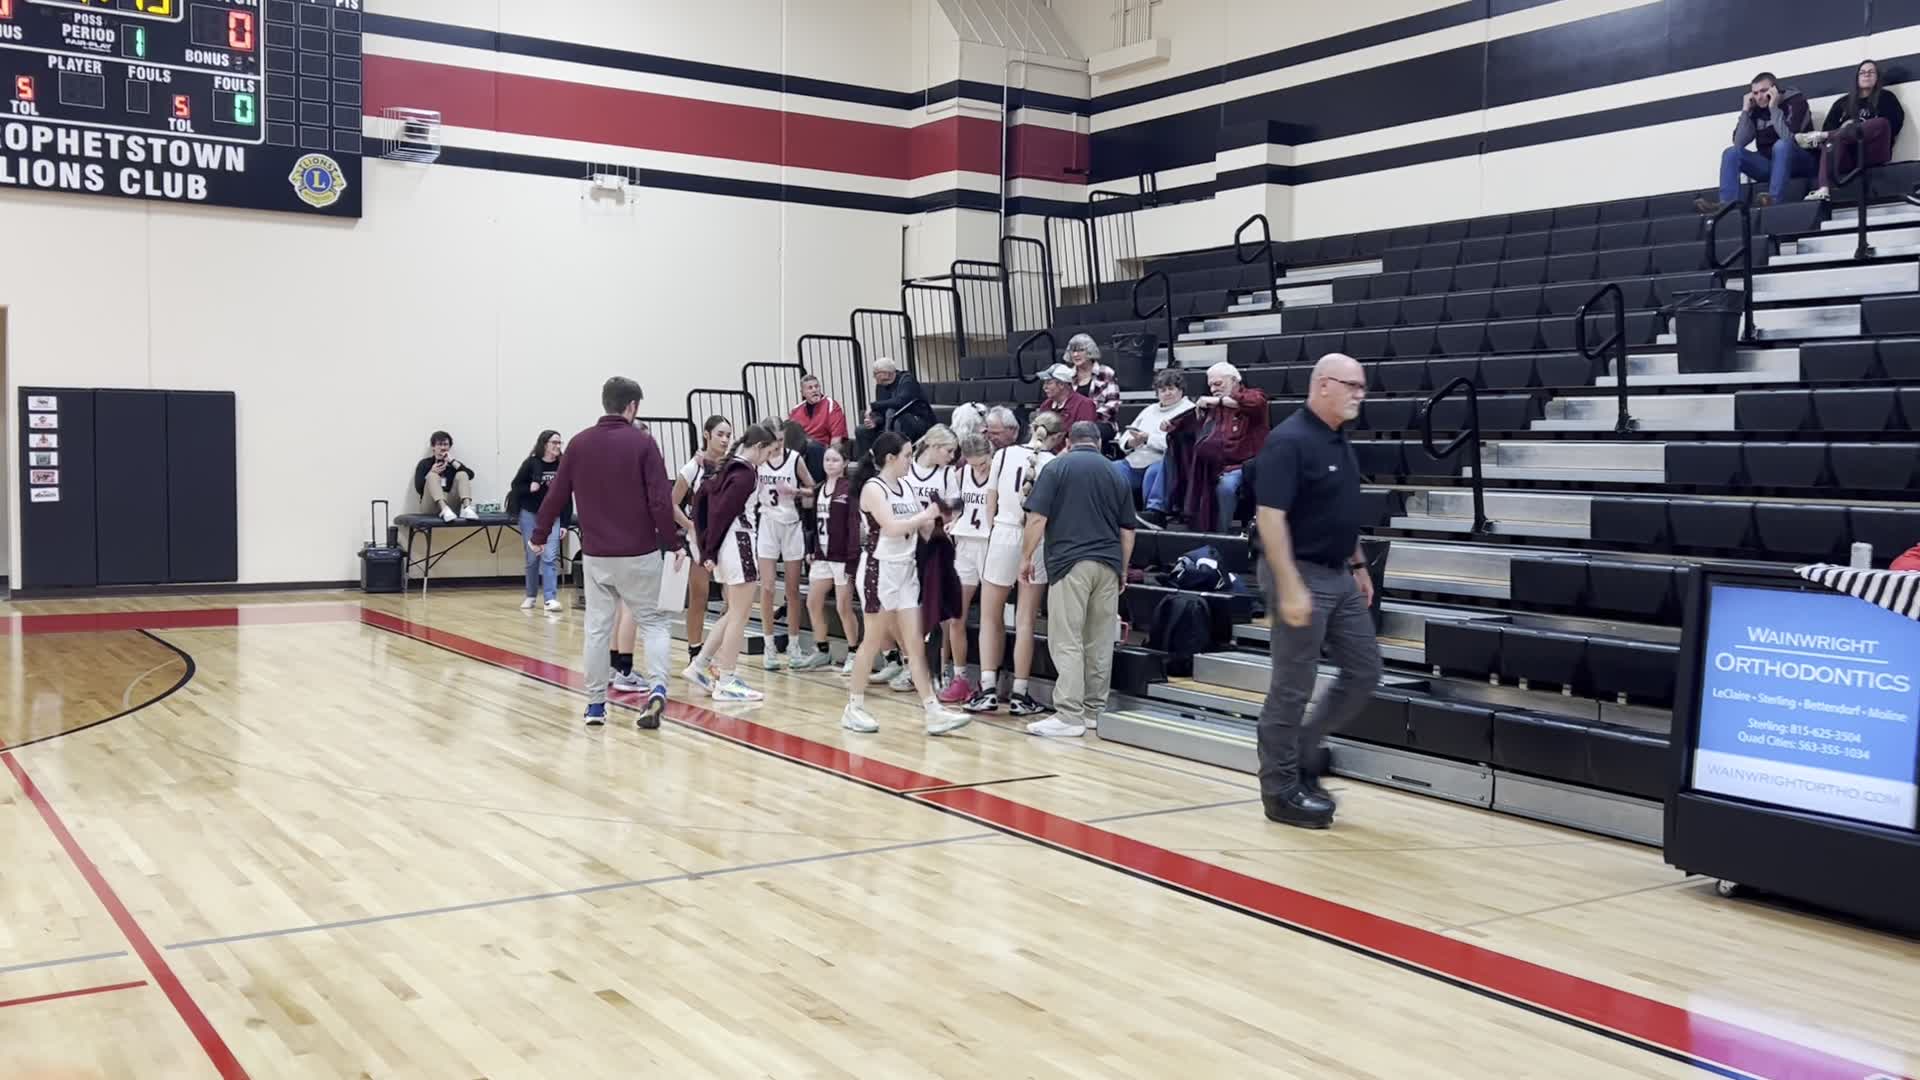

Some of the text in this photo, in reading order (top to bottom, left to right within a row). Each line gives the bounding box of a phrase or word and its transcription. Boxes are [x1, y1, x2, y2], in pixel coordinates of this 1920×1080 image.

[74, 12, 103, 26] POSS
[62, 23, 115, 42] PERIOD
[228, 11, 254, 50] 0
[135, 27, 144, 57] 1
[48, 55, 102, 74] PLAYER
[185, 50, 230, 67] BONUS
[128, 65, 171, 83] FOULS
[214, 76, 255, 93] FOULS
[9, 99, 39, 116] TOL
[234, 93, 254, 124] 0
[168, 117, 194, 133] TOL
[0, 122, 245, 172] OPHETSTOWN
[0, 155, 207, 201] LIONS CLUB
[311, 170, 327, 189] L
[769, 489, 779, 507] 3
[970, 508, 981, 530] 4
[1747, 625, 1880, 655] WAINWRIGHT
[1714, 652, 1911, 693] ORTHODONTICS
[1712, 687, 1751, 702] LeClaire
[1757, 693, 1797, 710] Sterling
[1803, 699, 1861, 716] Bettendorf
[1737, 731, 1766, 745] Quad
[1766, 735, 1796, 750] Cities:
